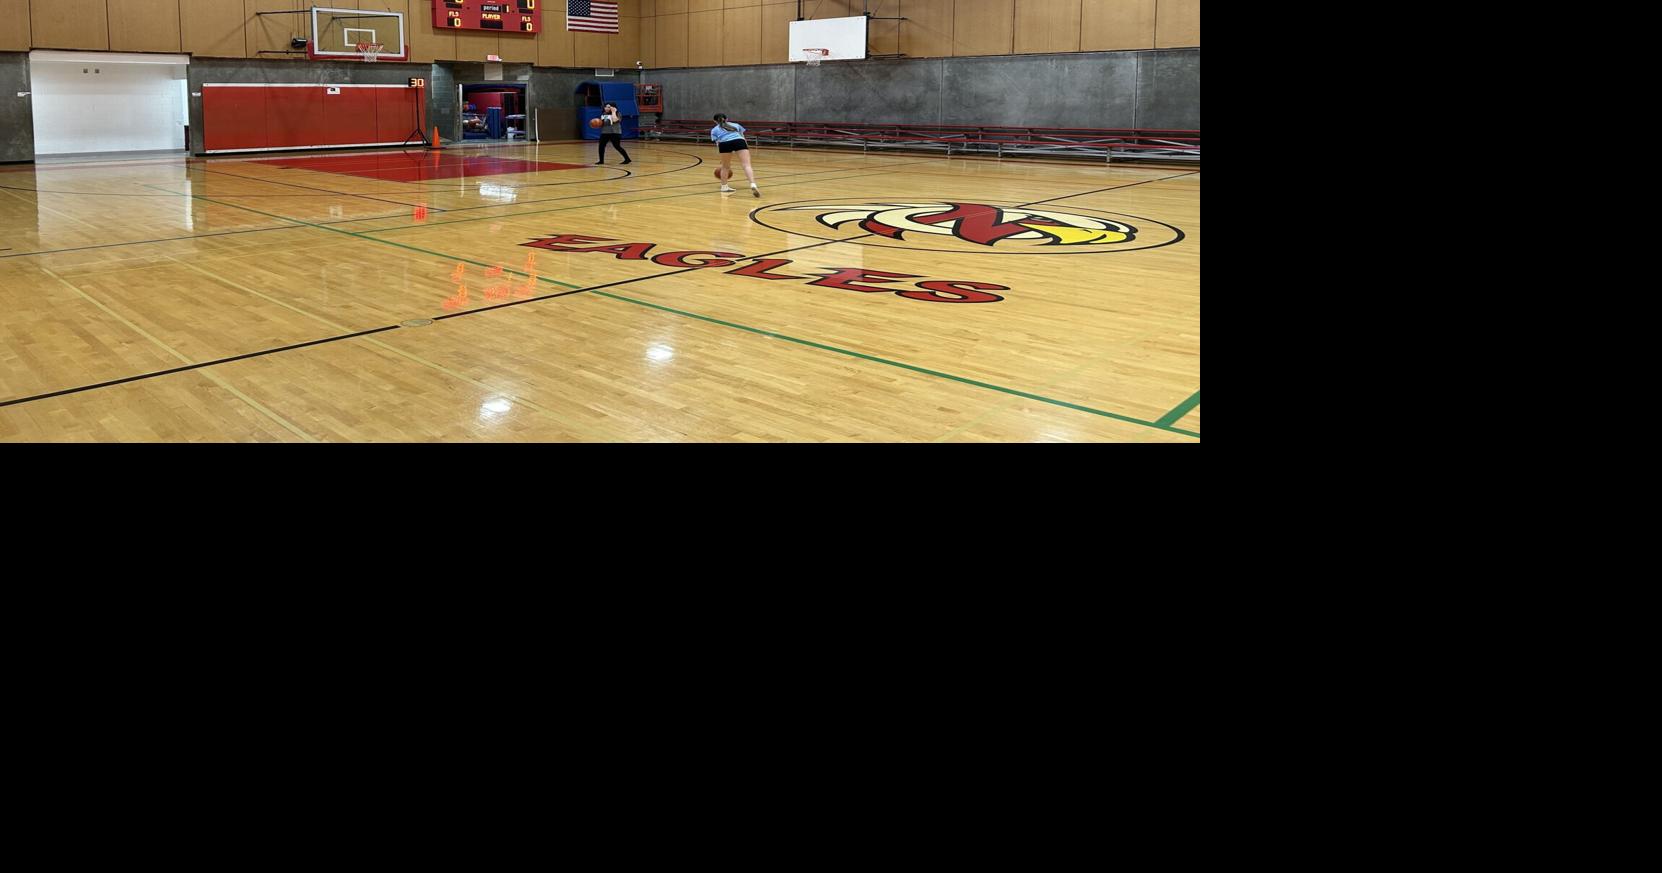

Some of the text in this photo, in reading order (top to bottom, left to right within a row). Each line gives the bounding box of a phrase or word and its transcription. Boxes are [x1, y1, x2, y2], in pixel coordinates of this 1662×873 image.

[454, 17, 461, 27] 0
[526, 22, 533, 31] 0
[410, 78, 424, 87] 30
[519, 234, 1011, 304] EAGLES
